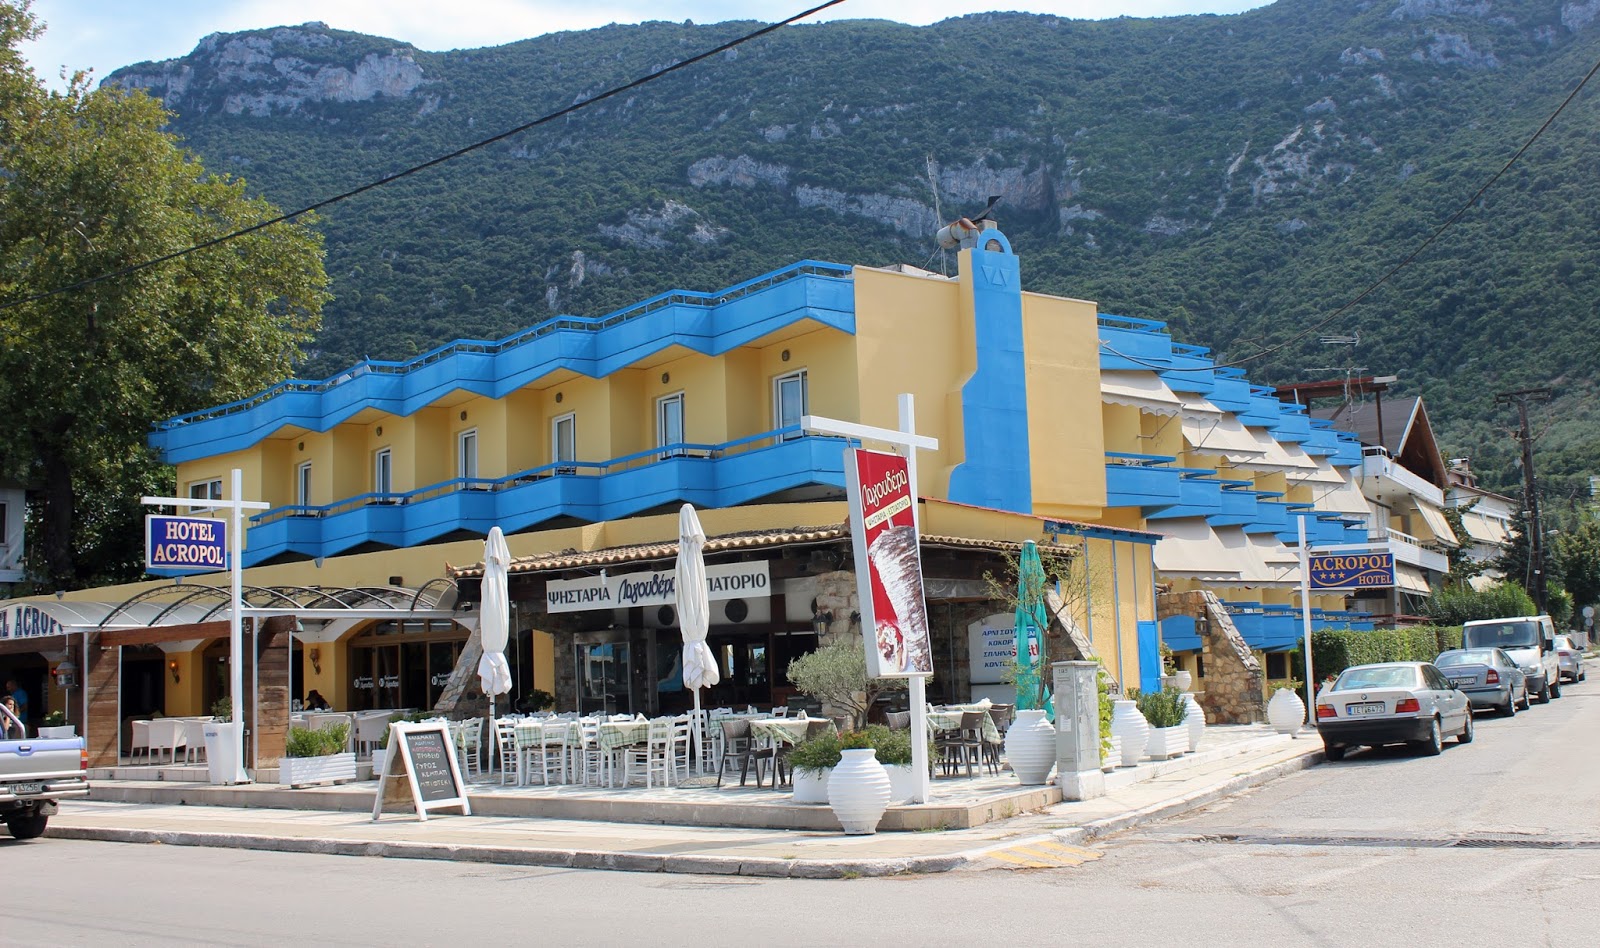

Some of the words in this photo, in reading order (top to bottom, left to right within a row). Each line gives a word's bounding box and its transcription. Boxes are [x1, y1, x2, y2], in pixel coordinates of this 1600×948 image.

[166, 521, 216, 542] HOTEL
[154, 543, 223, 565] ACROPOL
[1311, 555, 1392, 571] ACROPOL
[1358, 575, 1392, 585] HOTEL
[548, 587, 611, 605] ΨΗΣΤΑΡΙΑ
[706, 573, 767, 593] ΙΑΤΟΡΙΟ
[1000, 628, 1015, 636] ΣΟΥ
[983, 650, 1013, 658] ΣΠΛΗΝΑ
